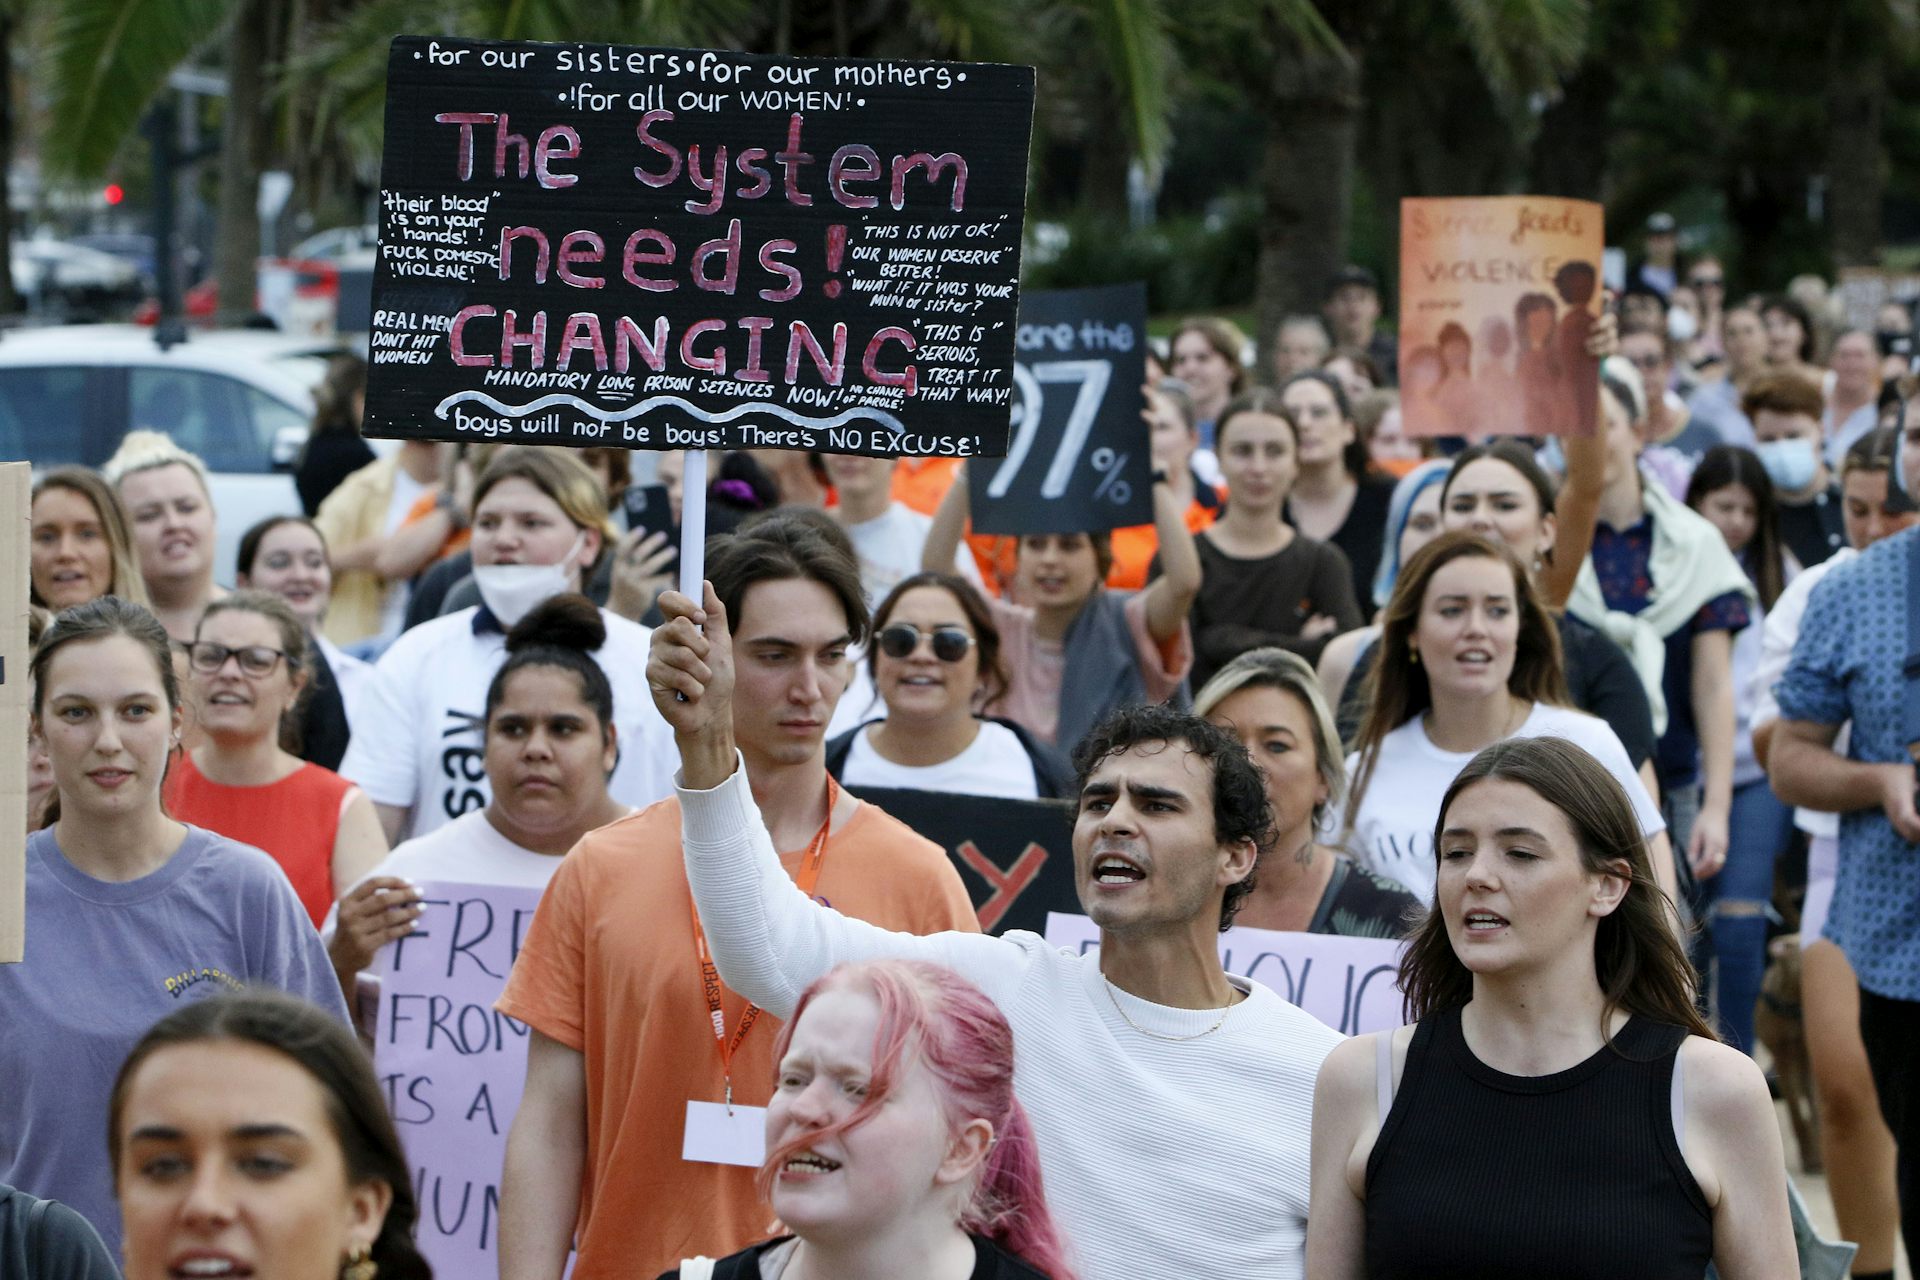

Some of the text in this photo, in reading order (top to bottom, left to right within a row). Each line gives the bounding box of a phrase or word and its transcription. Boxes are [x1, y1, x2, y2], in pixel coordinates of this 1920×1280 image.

[481, 51, 535, 69] our
[556, 46, 680, 77] sisters
[767, 64, 819, 86] our
[835, 63, 952, 90] mothers
[628, 84, 664, 111] all
[678, 91, 729, 113] our
[740, 91, 851, 112] WOMEN!
[434, 108, 969, 216] The System
[391, 212, 485, 229] is on your
[403, 227, 468, 245] hands!
[907, 225, 923, 239] IS
[927, 225, 961, 240] NOT
[888, 247, 937, 263] WOMEN
[879, 263, 943, 280] BETTER!
[1421, 256, 1558, 284] VIOLENCE
[895, 280, 914, 294] IF
[915, 281, 934, 296] IT
[869, 293, 904, 308] MUM
[373, 309, 456, 334] REAL MEN
[371, 331, 441, 350] DONT HIT
[1017, 319, 1135, 351] are the
[374, 350, 433, 365] WOMEN
[450, 304, 919, 397] CHANGING
[916, 345, 980, 366] SERIOUS,
[927, 368, 1002, 385] TREAT IT
[484, 370, 845, 411] MANDATORY LONG PRISON SETENCES NOW!
[849, 384, 907, 399] NO CHANCE
[919, 387, 1011, 406] THAT WAY!
[843, 395, 905, 411] OF PAROLE!
[455, 407, 982, 457] boys will not be boys! There's NO EXCUSE!
[728, 1001, 761, 1056] RESPECT
[382, 1073, 499, 1135] IS A
